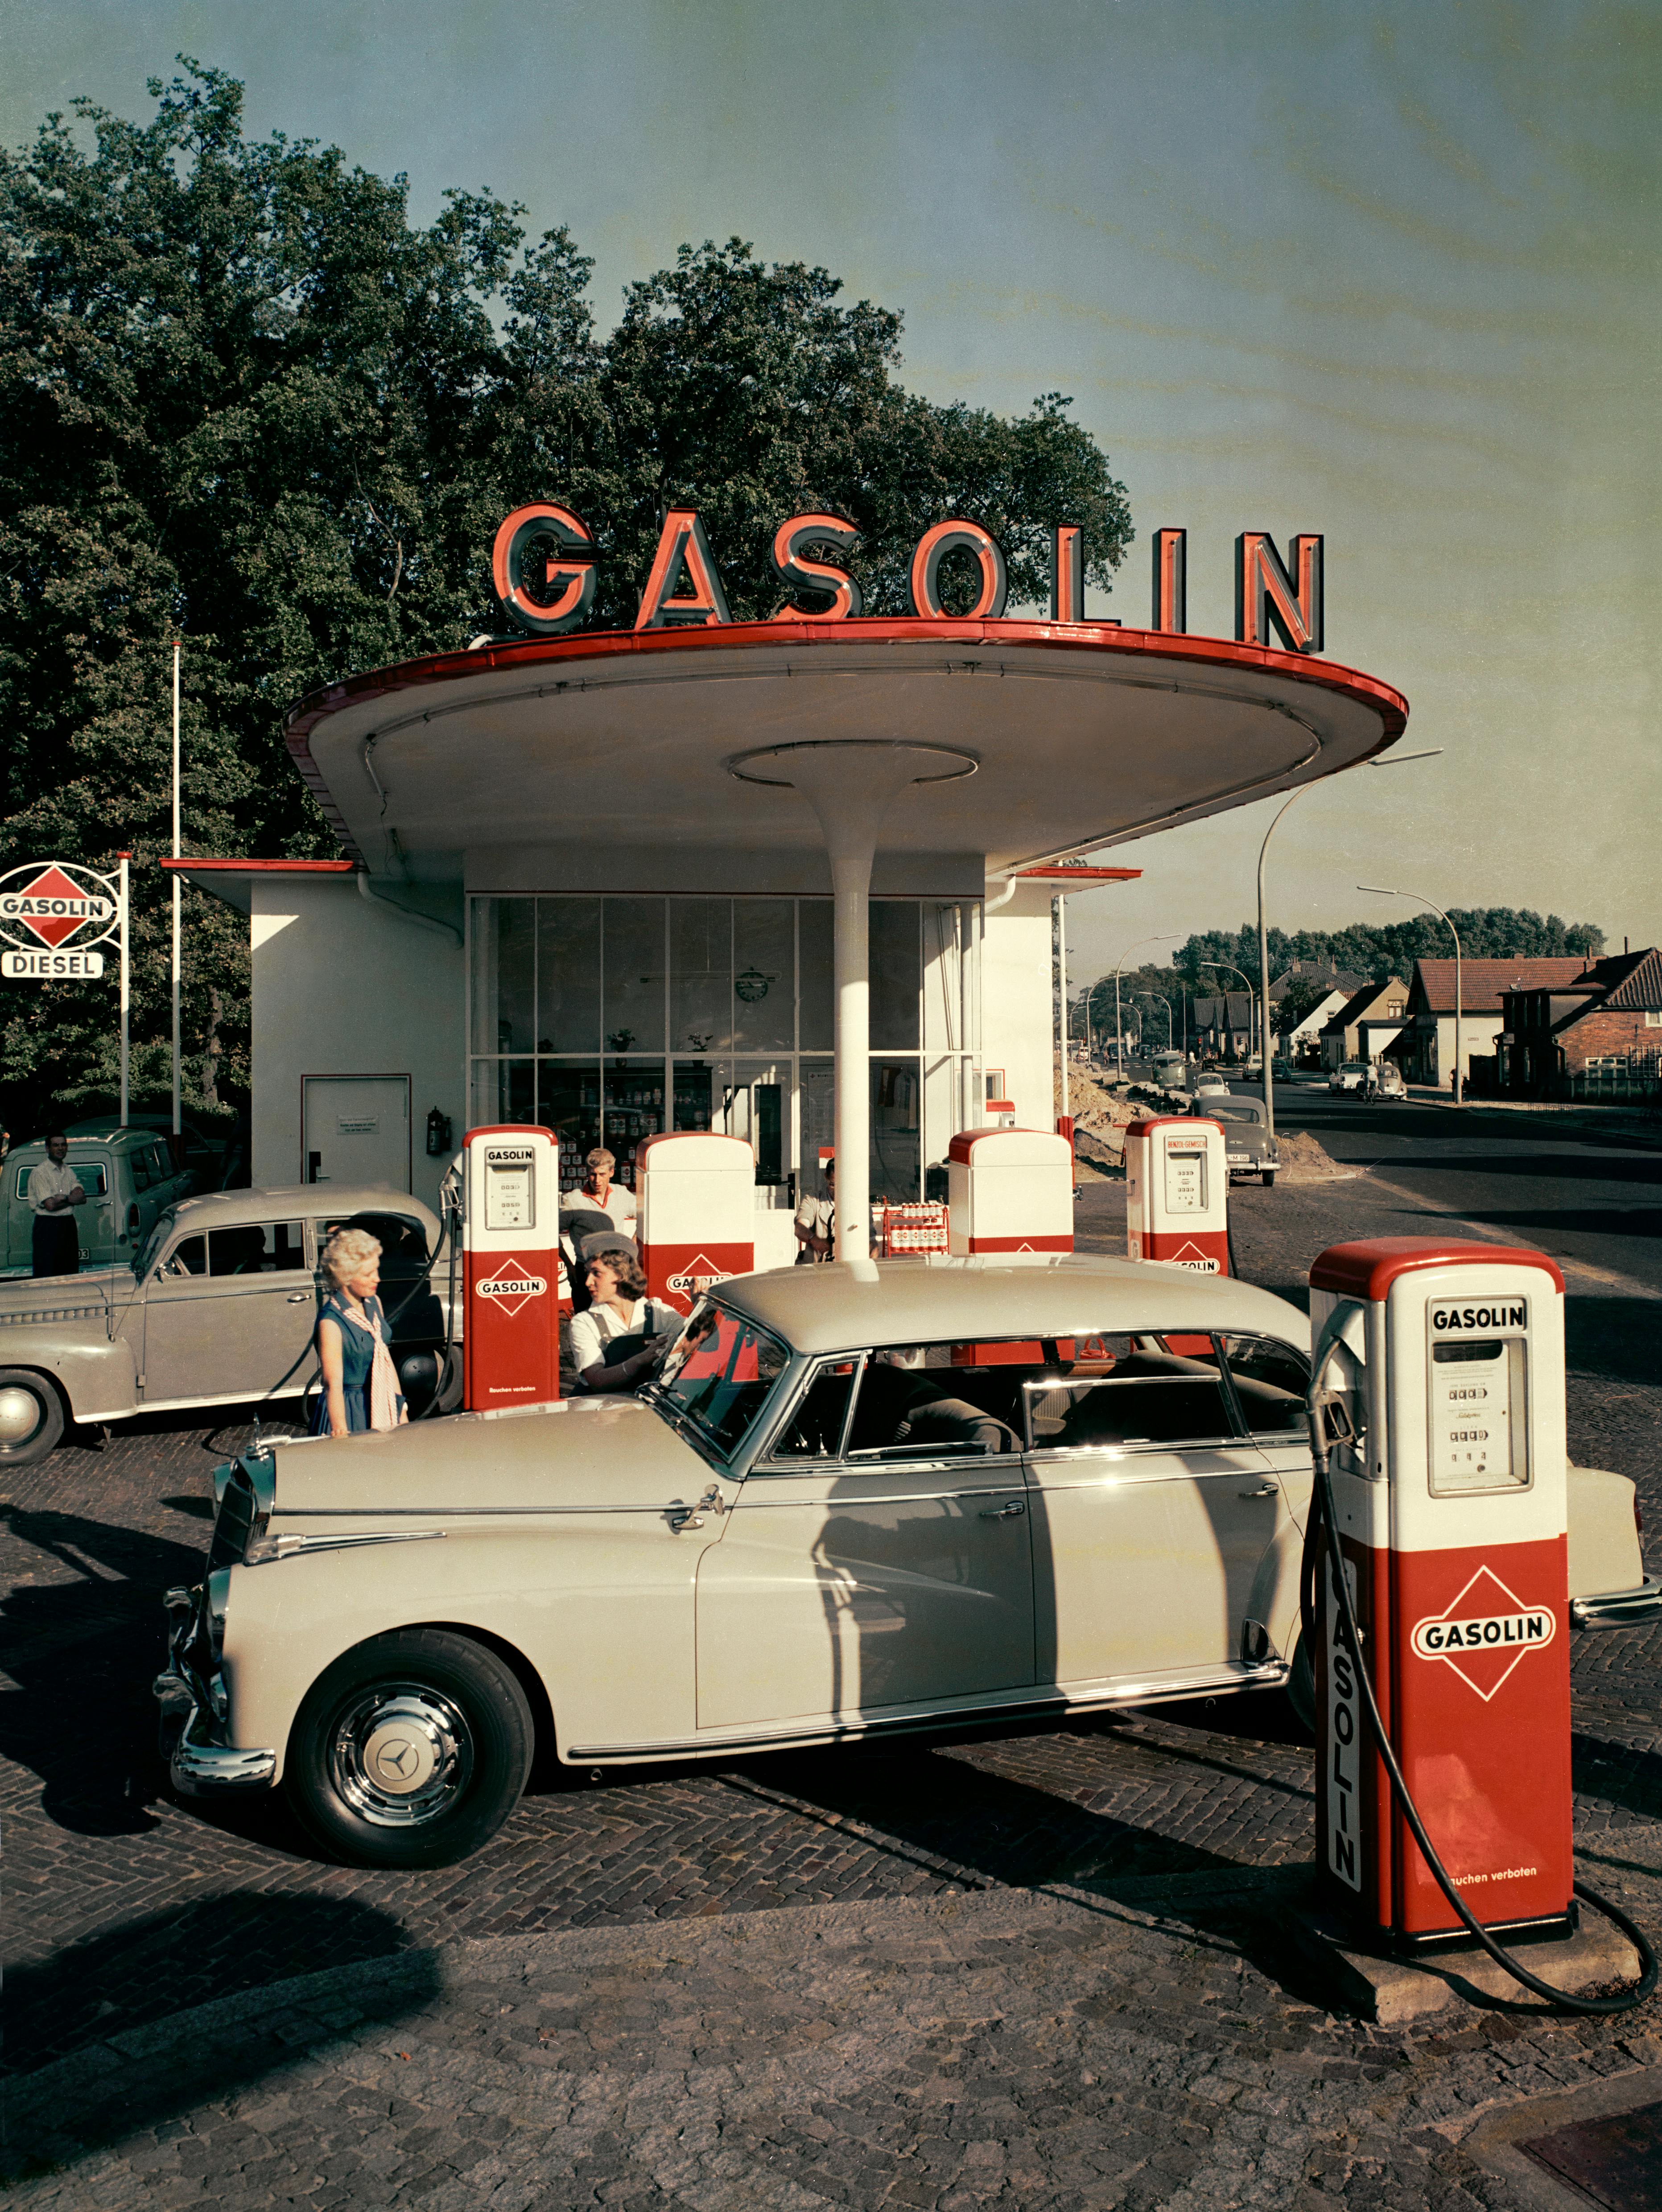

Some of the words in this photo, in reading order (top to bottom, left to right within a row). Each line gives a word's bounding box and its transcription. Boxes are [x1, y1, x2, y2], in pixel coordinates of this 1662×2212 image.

[493, 501, 1324, 655] GASOLIN
[3, 898, 103, 916] GASOLIN
[13, 956, 95, 974] DIESEL
[1168, 1141, 1206, 1149] BENZOL-GEMISCH
[488, 1151, 532, 1160] GASOLIN
[483, 1281, 540, 1293] GASOLIN
[1433, 1306, 1523, 1330] GASOLIN
[1425, 1616, 1543, 1649] GASOLIN
[1450, 1874, 1488, 1886] auchen
[1491, 1867, 1537, 1881] verboten
